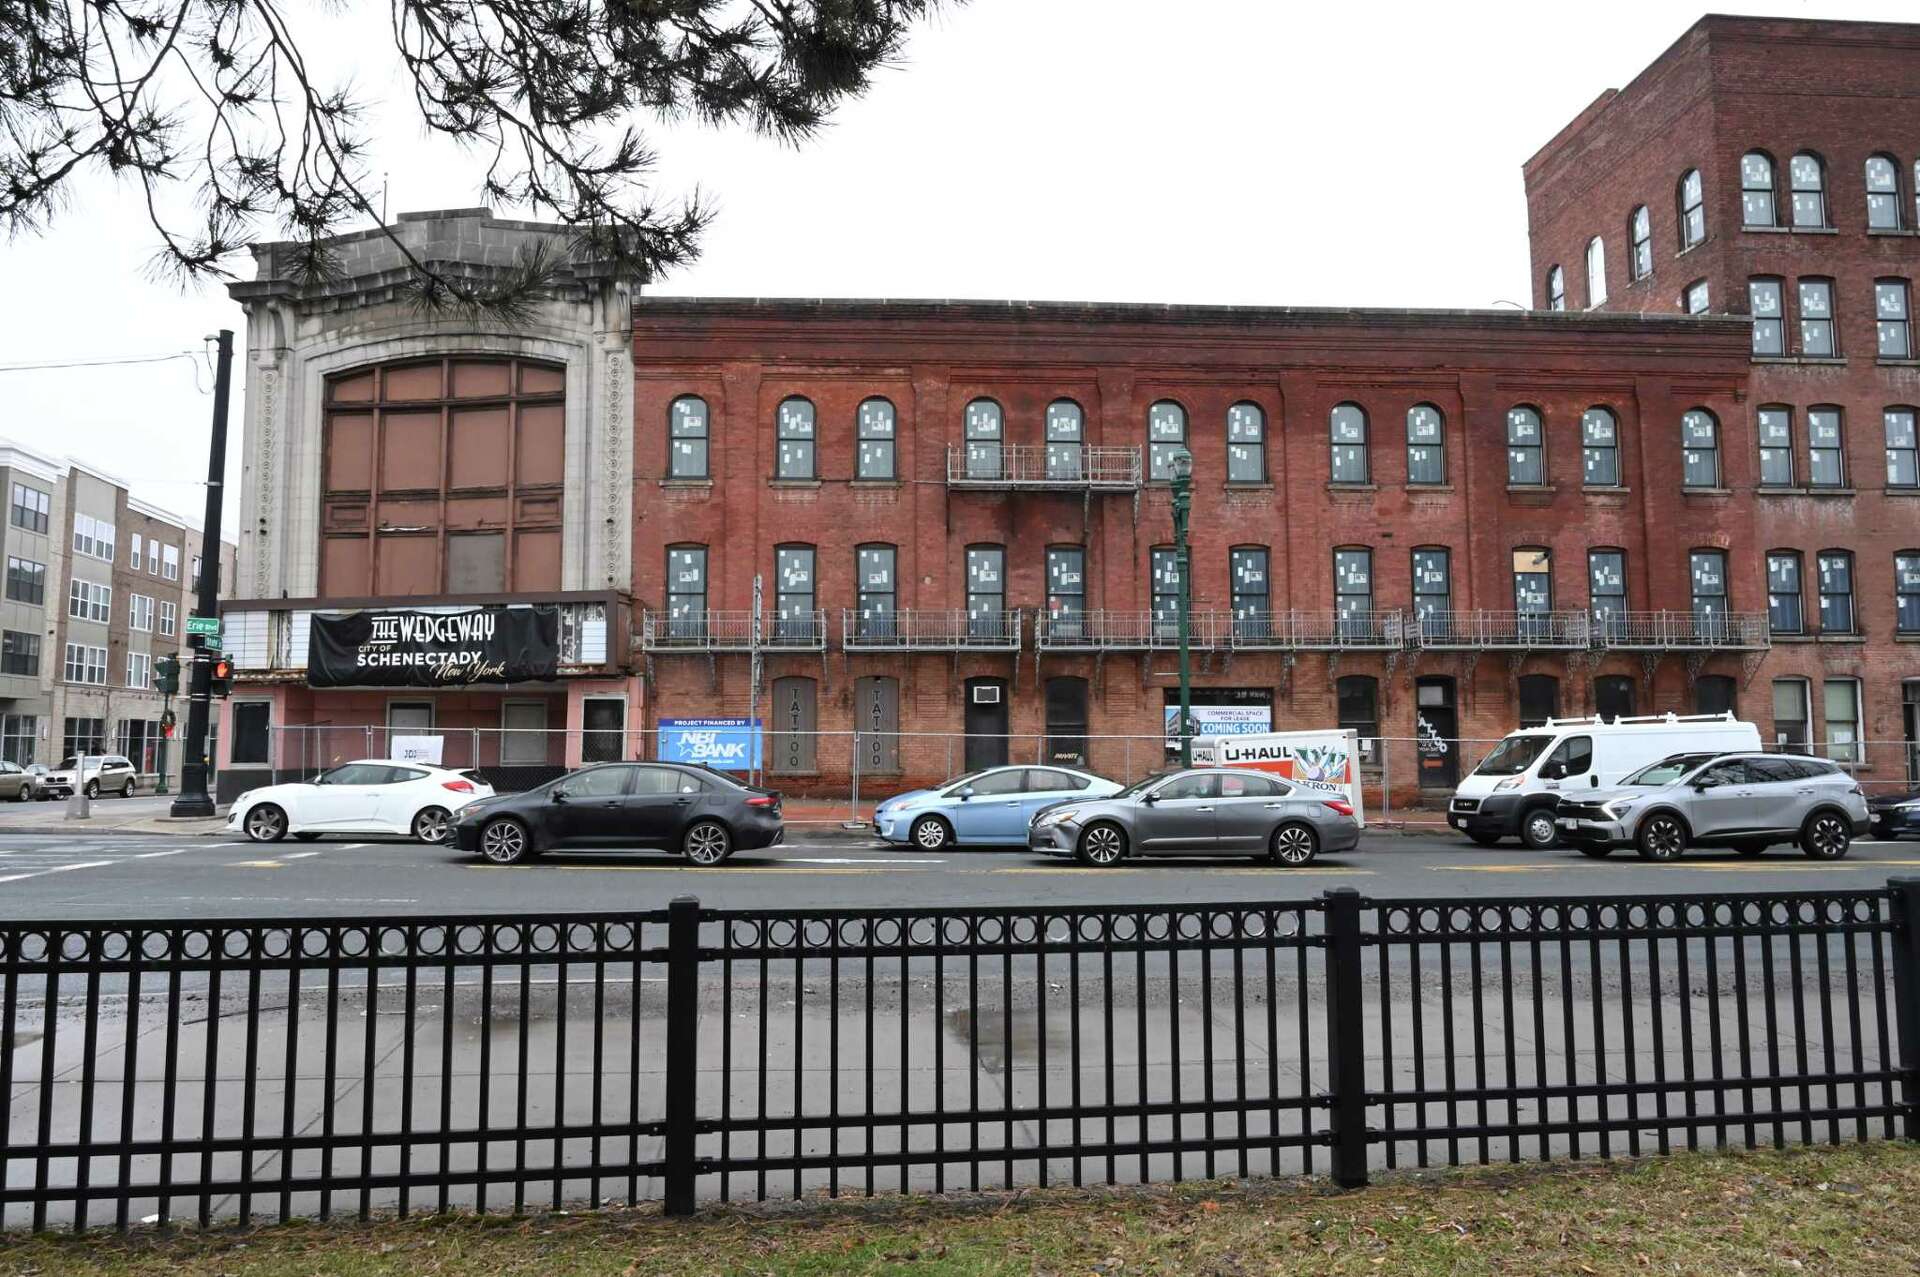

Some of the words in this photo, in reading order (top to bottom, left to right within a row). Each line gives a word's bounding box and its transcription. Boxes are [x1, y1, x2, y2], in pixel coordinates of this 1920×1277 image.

[187, 620, 204, 631] Erie
[371, 619, 398, 640] THE
[400, 613, 495, 643] WEDGEWAY
[358, 645, 376, 653] CITY
[380, 644, 392, 652] OF
[357, 651, 482, 667] SCHENECTADY
[429, 661, 465, 680] New
[466, 660, 507, 683] York
[790, 688, 801, 767] TATTOO
[871, 690, 882, 766] TATTOO
[1201, 723, 1242, 734] COMING
[1241, 723, 1270, 734] SOON
[690, 743, 746, 758] BANK
[1192, 751, 1214, 762] U-HAUL
[1225, 746, 1292, 761] U-HAUL
[1297, 779, 1337, 792] KRON
